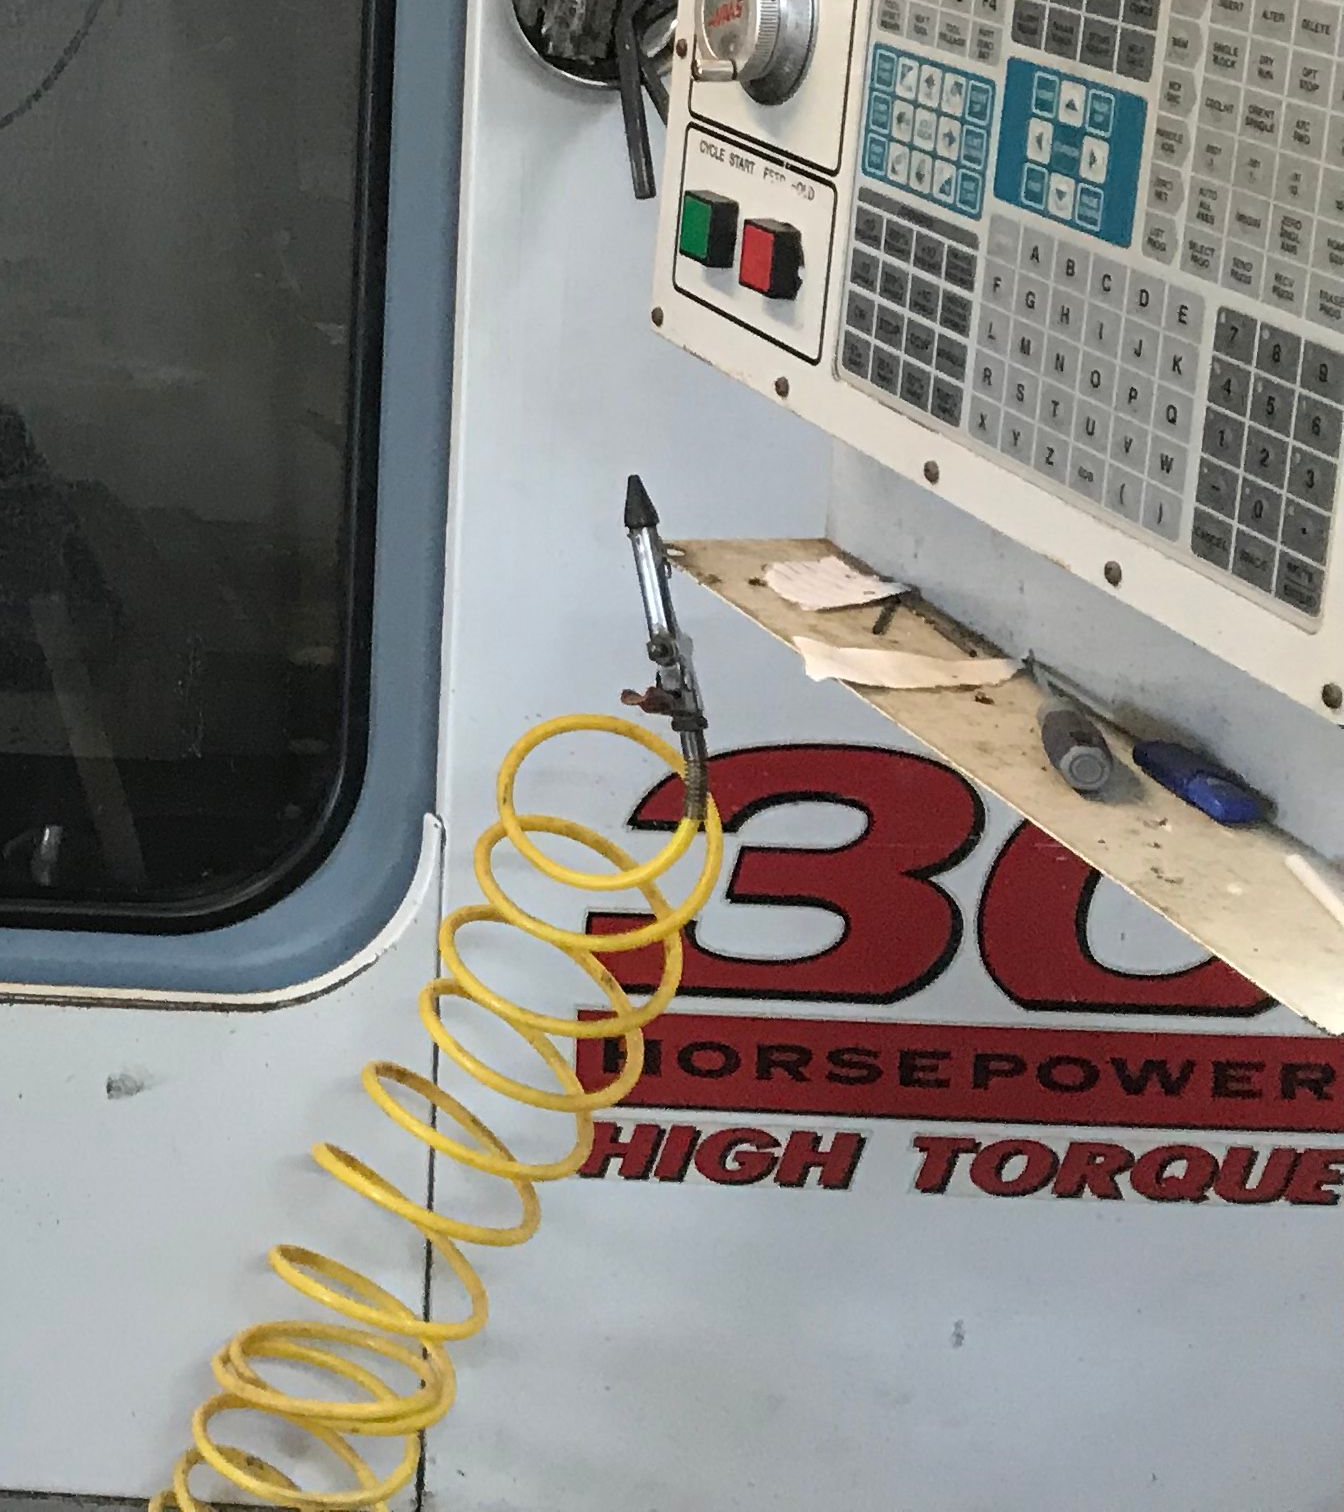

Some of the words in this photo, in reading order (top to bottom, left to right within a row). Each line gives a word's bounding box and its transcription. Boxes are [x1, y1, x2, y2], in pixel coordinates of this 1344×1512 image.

[699, 139, 726, 163] CYCLE
[729, 152, 756, 175] START
[1030, 245, 1040, 264] A
[1065, 258, 1075, 277] B
[993, 277, 1002, 292] F
[1101, 274, 1112, 292] C
[1025, 291, 1036, 309] G
[1139, 288, 1149, 308] D
[1060, 305, 1071, 325] H
[1177, 305, 1189, 325] E
[988, 321, 996, 340] L
[1098, 322, 1104, 340] I
[1229, 325, 1239, 342] 7
[1019, 337, 1031, 356] M
[1134, 339, 1143, 358] J
[1272, 343, 1282, 363] 8
[1055, 353, 1065, 372] N
[1172, 354, 1183, 375] K
[983, 367, 993, 386] R
[1090, 370, 1101, 389] O
[1318, 363, 1329, 383] 9
[1016, 384, 1025, 402] S
[1128, 386, 1138, 405] P
[1223, 377, 1232, 396] 4
[1051, 400, 1060, 418] T
[1166, 404, 1178, 425] Q
[1266, 395, 1276, 416] 5
[978, 413, 987, 431] X
[1085, 416, 1096, 436] U
[1311, 415, 1322, 436] 6
[1012, 430, 1021, 448] Y
[1124, 435, 1134, 454] V
[1218, 428, 1225, 447] 1
[1045, 446, 1055, 466] Z
[1160, 453, 1174, 474] W
[1260, 447, 1271, 469] 2
[1306, 469, 1316, 489] 3
[1254, 499, 1264, 519] 0
[600, 1035, 1335, 1103] HORSEPOWER
[578, 1120, 870, 1191] HIGH
[914, 1135, 1344, 1208] TORQUE
